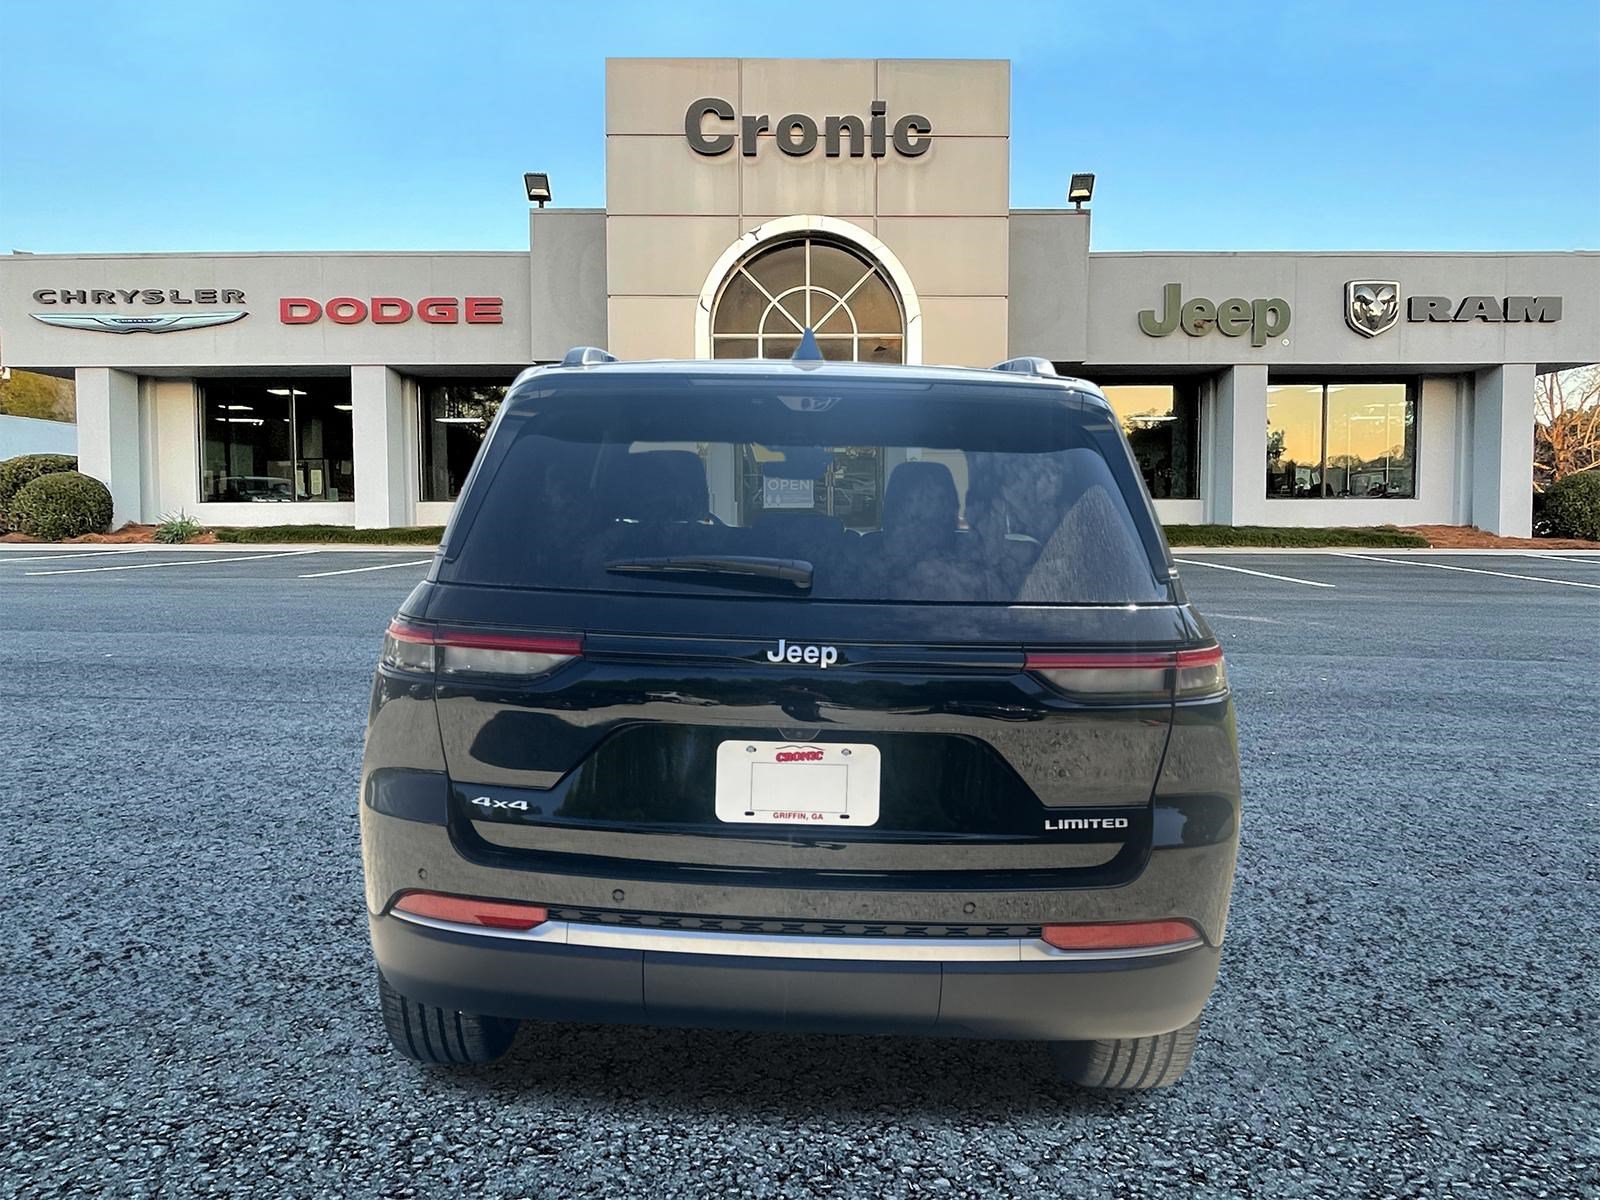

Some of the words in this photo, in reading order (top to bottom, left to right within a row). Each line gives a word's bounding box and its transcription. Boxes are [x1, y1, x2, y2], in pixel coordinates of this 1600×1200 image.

[685, 97, 932, 158] Cronic
[32, 288, 247, 305] CHRYSLER
[280, 296, 503, 325] DODGE
[1138, 283, 1292, 347] Jeep
[1407, 295, 1562, 323] RAM
[767, 479, 810, 490] OPEN
[767, 639, 838, 669] Jeep
[471, 796, 529, 811] 4x4
[773, 812, 808, 820] GRIFFIN,
[1044, 818, 1129, 831] LIMITED
